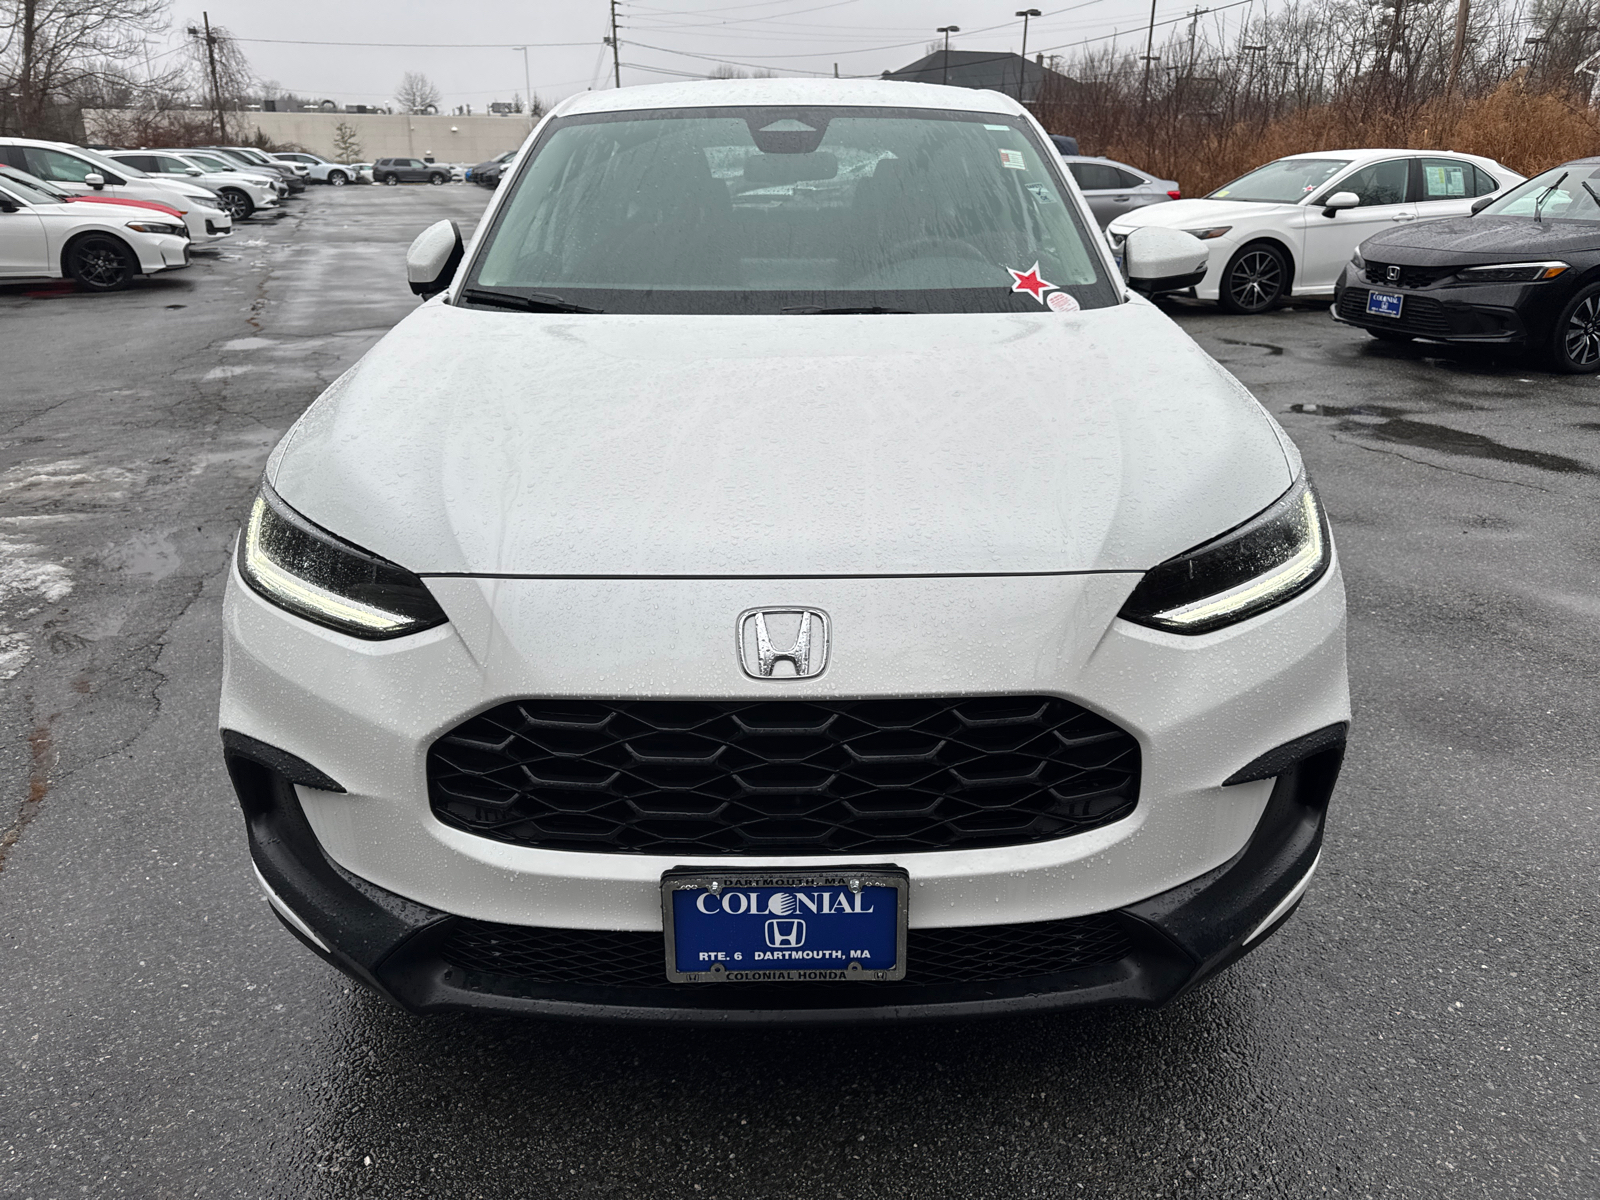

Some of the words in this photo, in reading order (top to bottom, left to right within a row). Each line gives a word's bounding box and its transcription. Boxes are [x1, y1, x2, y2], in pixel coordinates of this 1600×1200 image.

[696, 892, 874, 916] COLONIAL
[699, 952, 731, 961] RTE.
[733, 952, 743, 961] 6
[754, 951, 846, 961] DARTMOUTH,
[850, 950, 871, 959] MA
[726, 971, 794, 981] COLONIAL
[799, 970, 847, 980] HONDA
